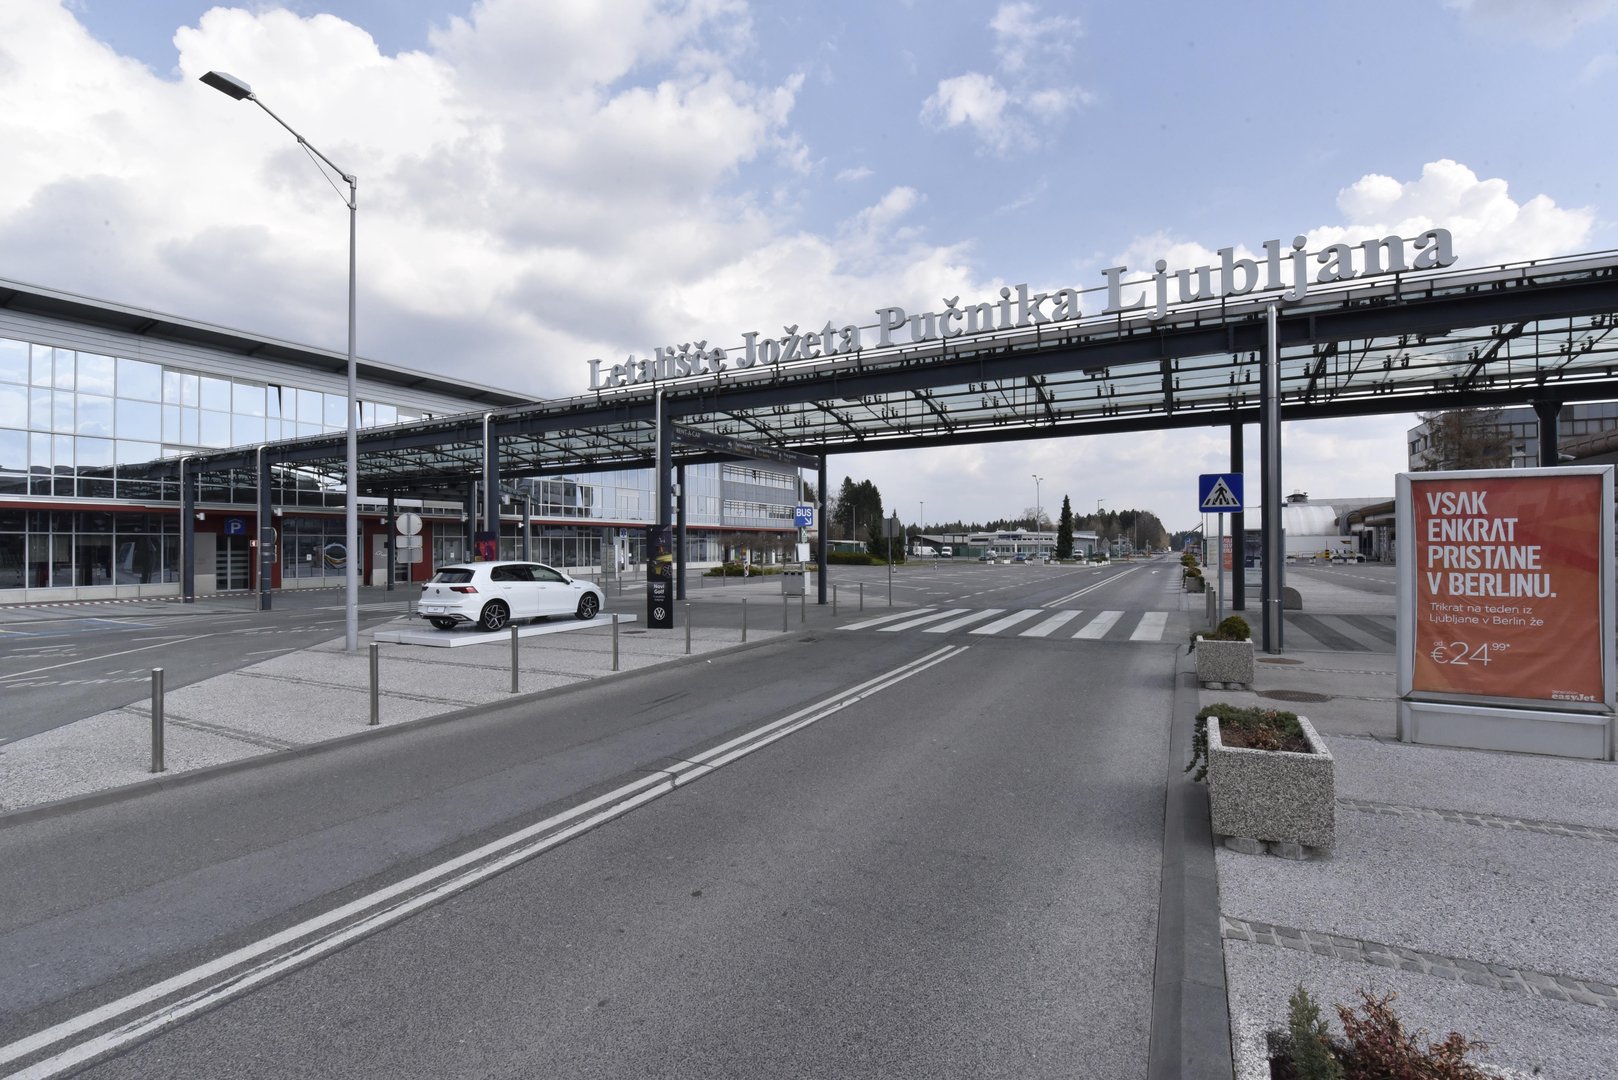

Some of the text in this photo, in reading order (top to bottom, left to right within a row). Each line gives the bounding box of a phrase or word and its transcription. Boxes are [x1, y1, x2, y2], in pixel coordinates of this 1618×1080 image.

[587, 228, 1459, 391] Letališče Jožeta Pučnika Ljubljana
[796, 508, 812, 517] BUS
[1426, 491, 1488, 515] VSAK
[231, 522, 241, 534] P
[1428, 518, 1518, 542] ENKRAT
[1428, 545, 1541, 569] PRISTANE
[1426, 572, 1557, 598] V BERLINU.
[1430, 602, 1464, 612] Trikrat
[1485, 605, 1519, 614] teden
[1523, 606, 1533, 615] iz
[1429, 613, 1545, 627] Ljubljane v Berlin že
[1551, 693, 1595, 702] easyJet
